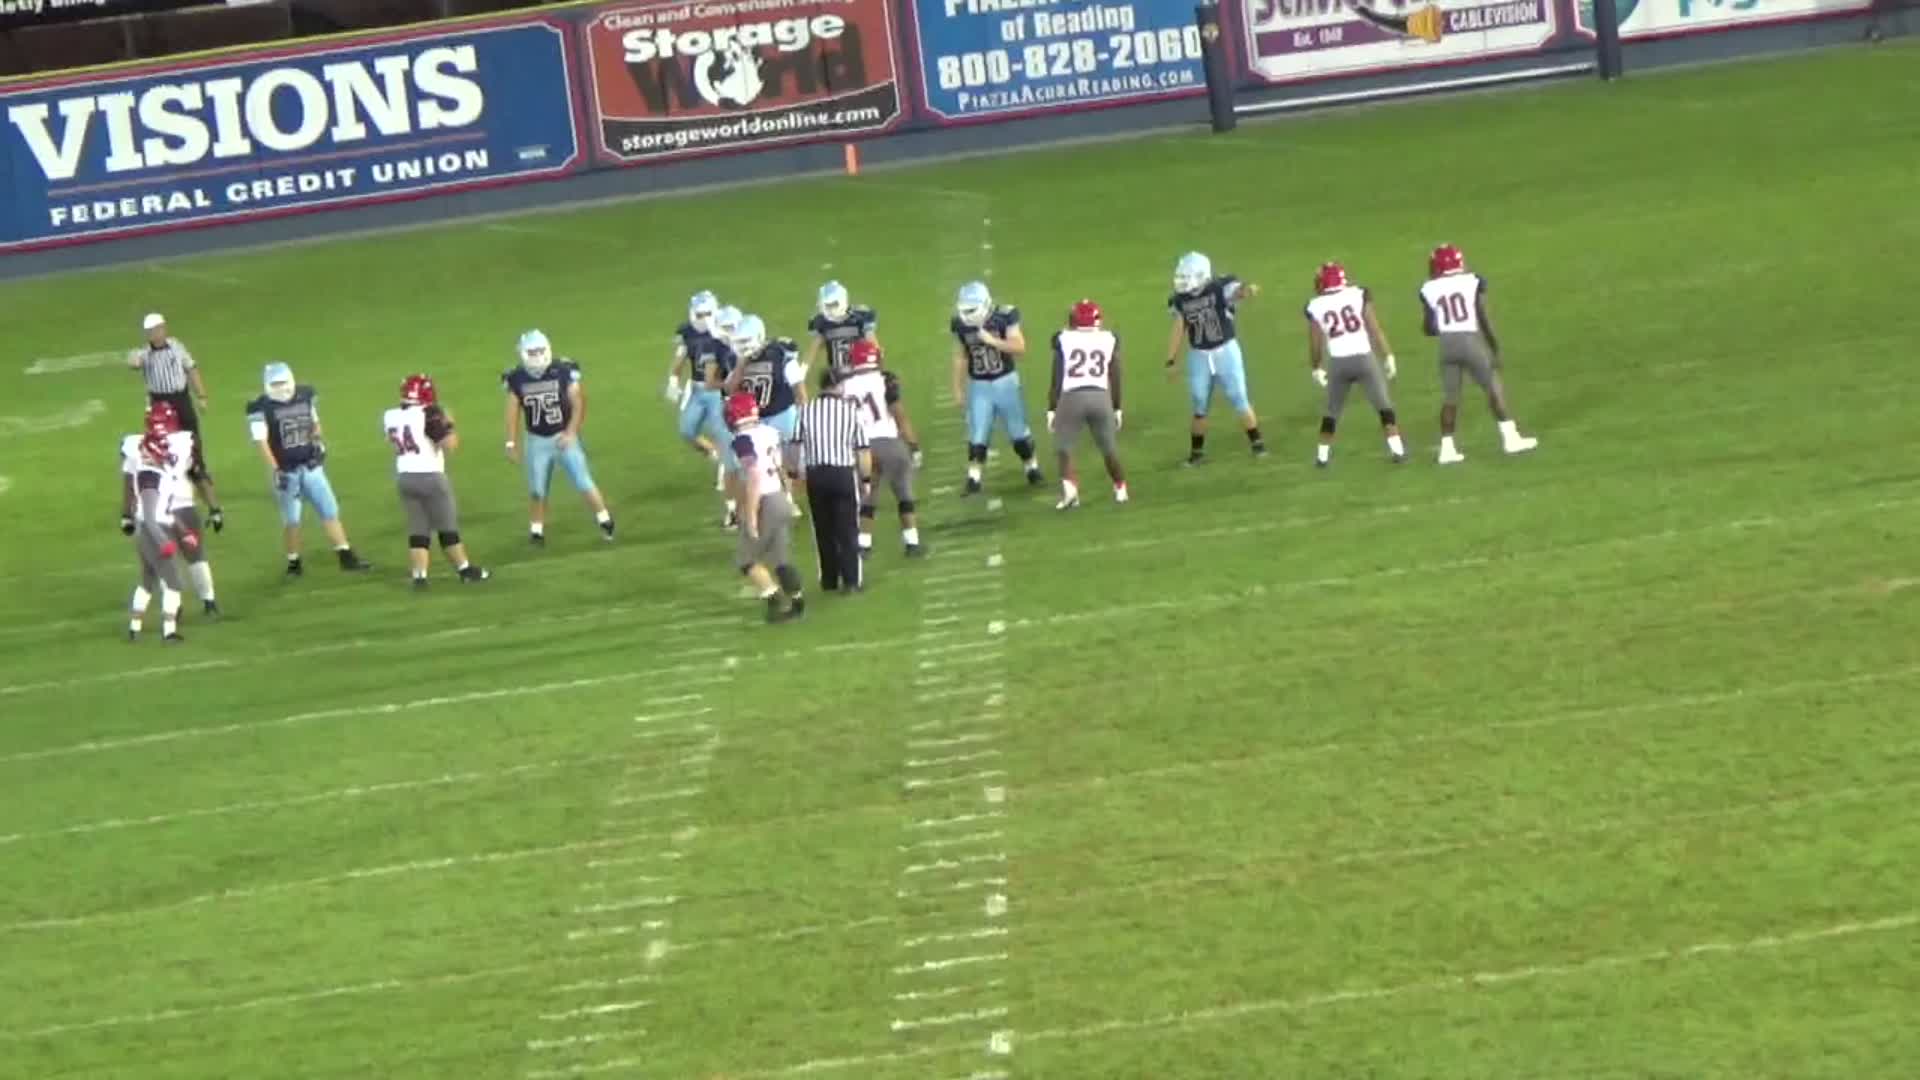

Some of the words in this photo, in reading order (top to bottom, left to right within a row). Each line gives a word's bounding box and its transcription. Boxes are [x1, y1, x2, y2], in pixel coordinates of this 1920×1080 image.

[603, 13, 654, 31] Clean
[656, 6, 690, 25] and
[1001, 18, 1025, 42] of
[1034, 5, 1136, 37] Reading
[622, 14, 845, 63] Storage
[937, 25, 1202, 90] 800-828-2060
[8, 45, 484, 180] VISIONS
[622, 105, 881, 151] storageworldonline.com
[50, 189, 212, 226] FEDERAL
[226, 169, 356, 203] CREDIT
[371, 148, 490, 183] UNION
[1324, 304, 1361, 339] 26
[1436, 291, 1469, 326] 10
[1068, 348, 1106, 378] 23
[523, 392, 563, 426] 75
